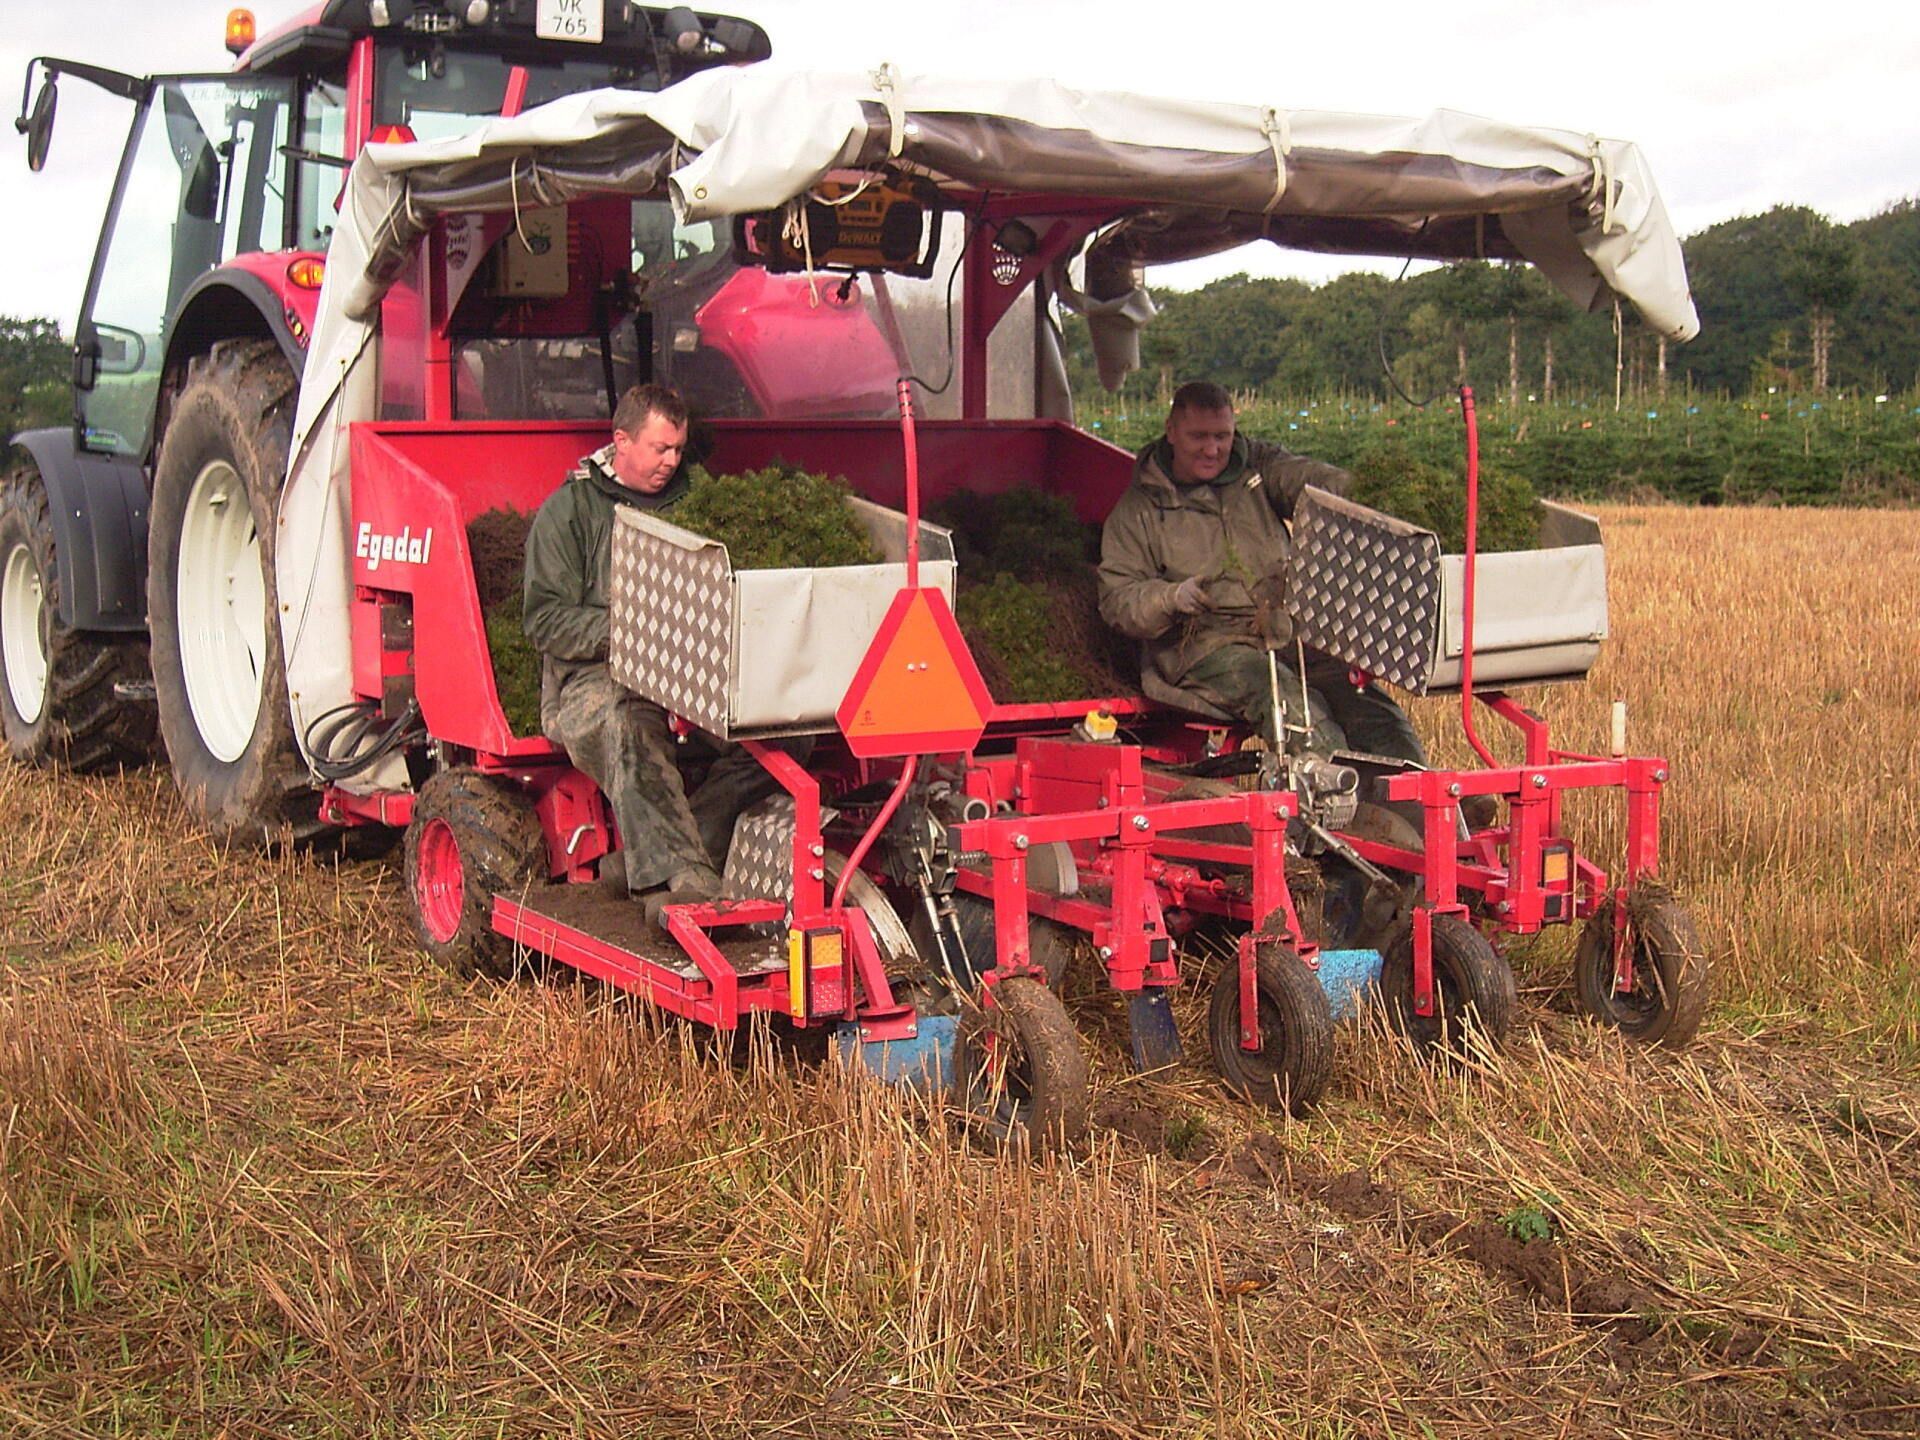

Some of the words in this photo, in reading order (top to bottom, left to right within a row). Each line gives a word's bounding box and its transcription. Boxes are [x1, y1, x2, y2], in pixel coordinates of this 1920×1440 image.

[559, 0, 582, 13] VK
[552, 16, 587, 35] 765
[356, 521, 433, 571] Egedal
